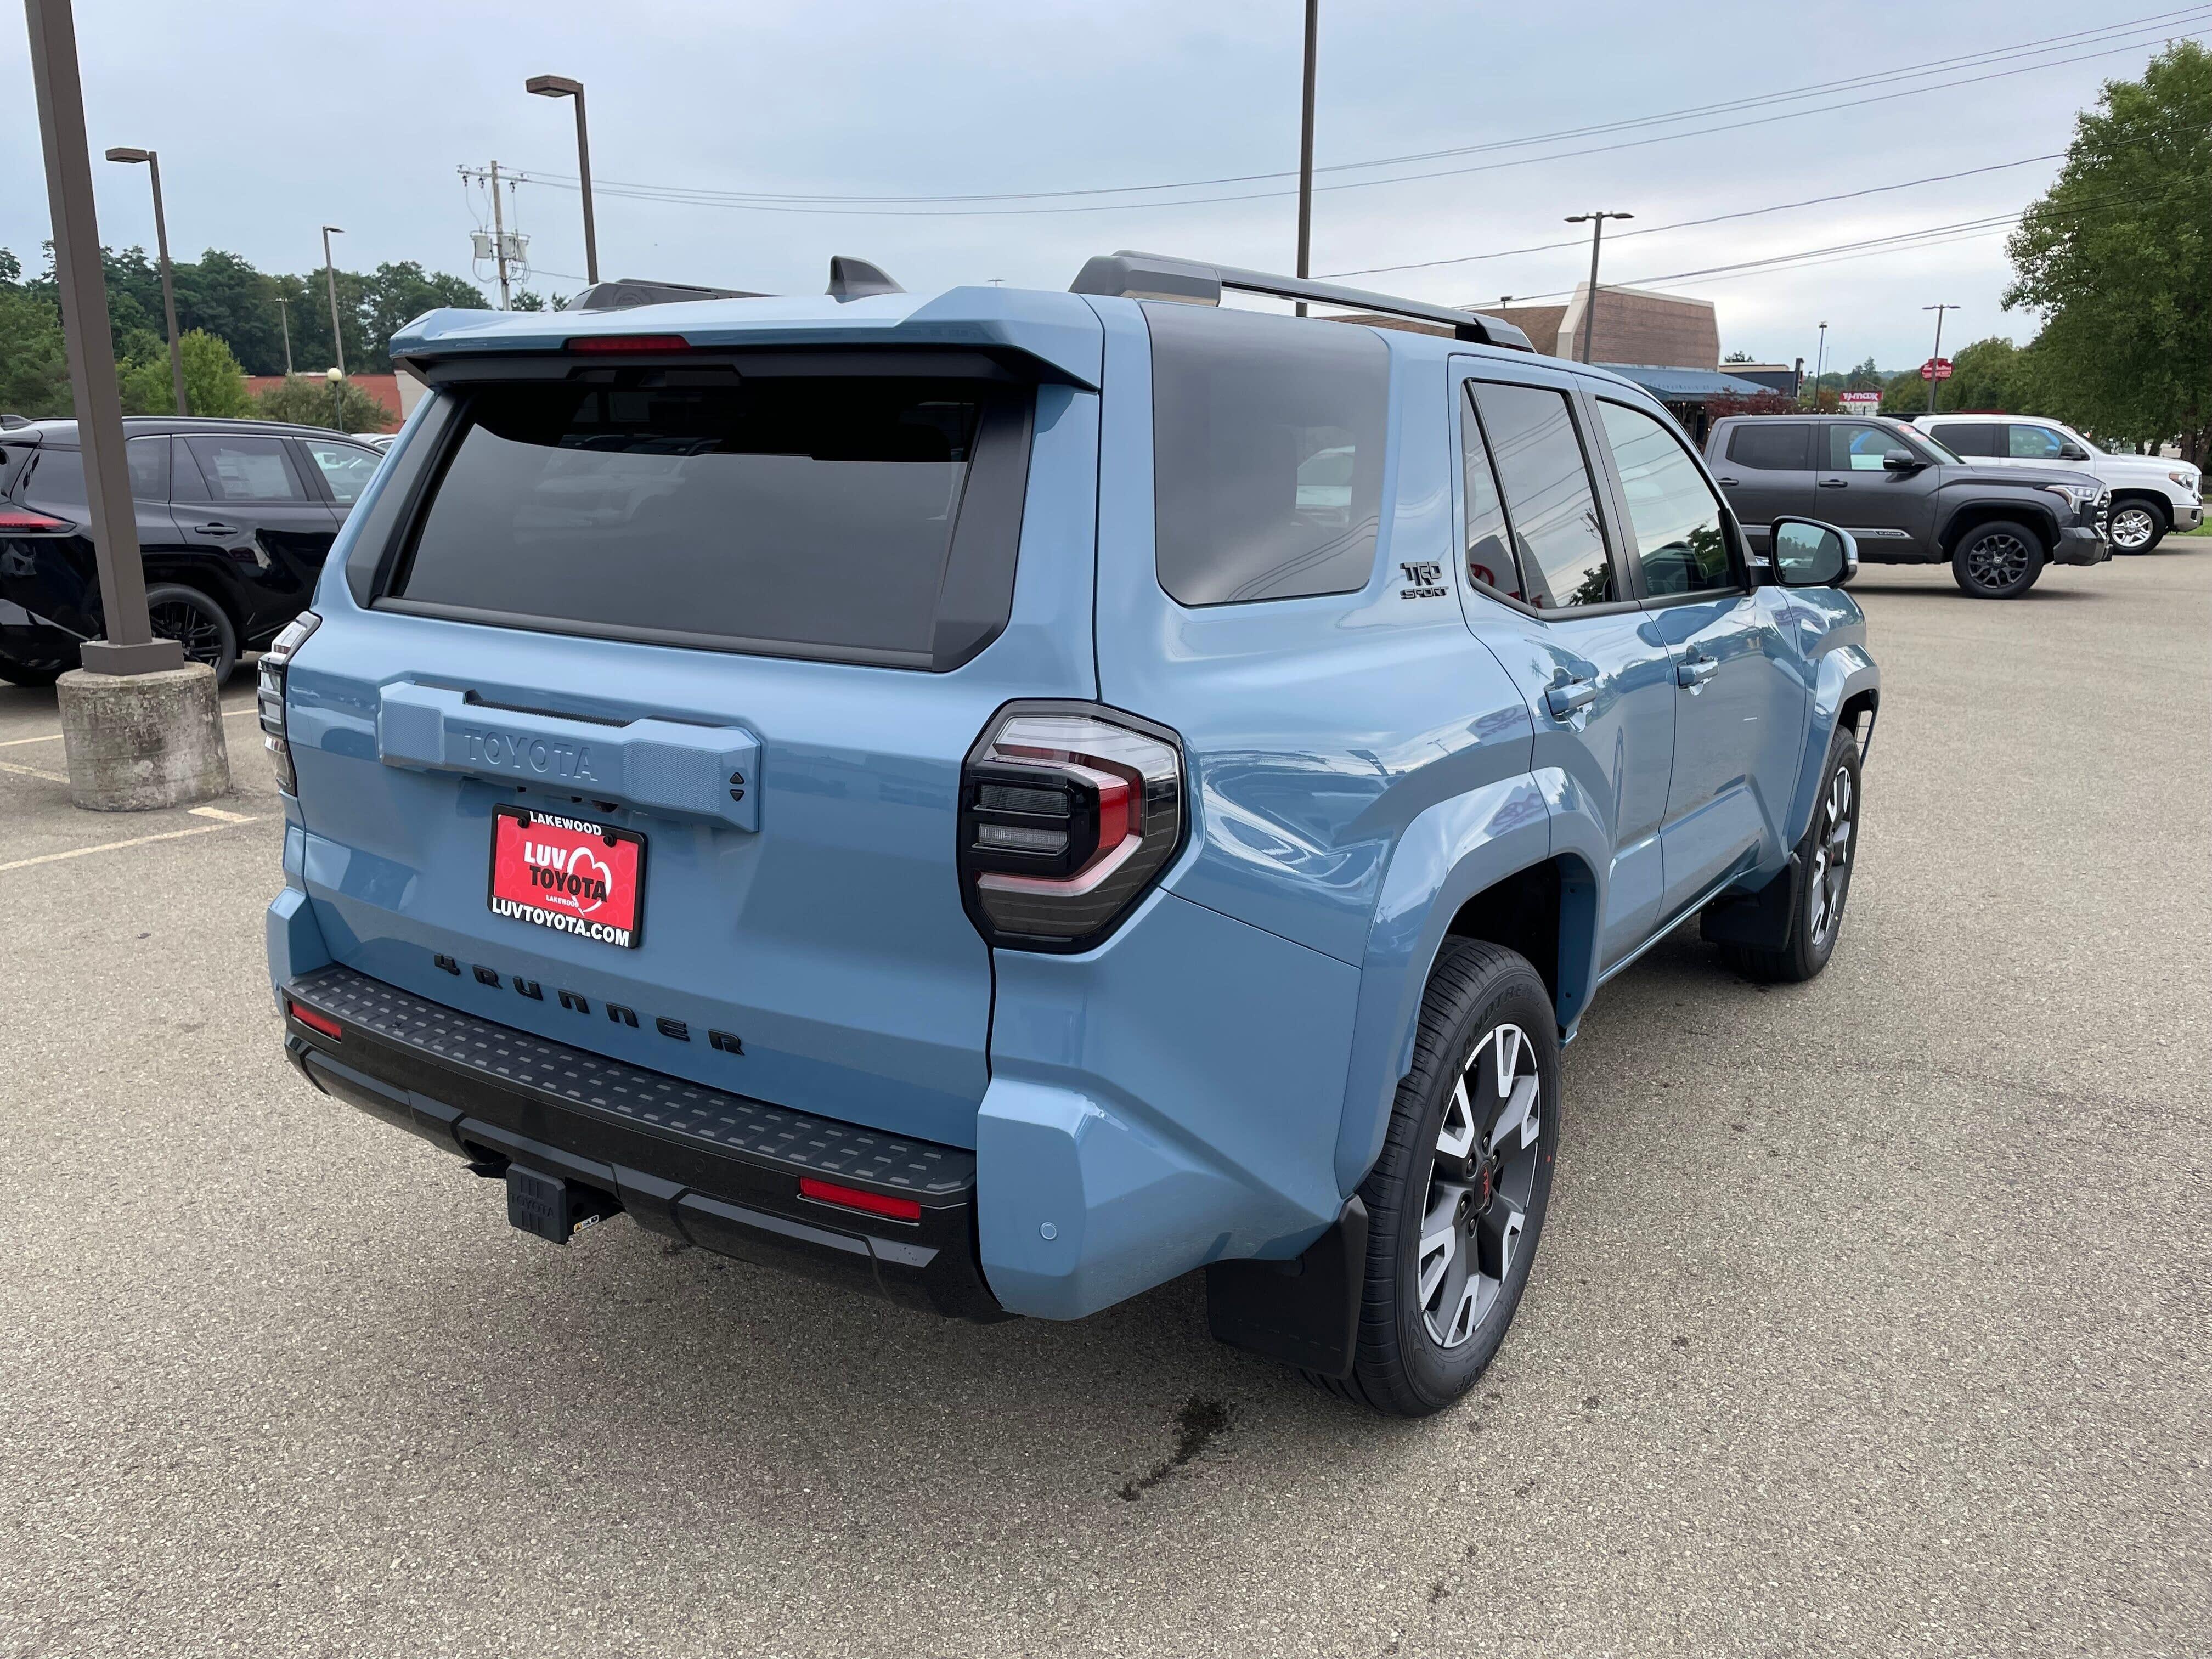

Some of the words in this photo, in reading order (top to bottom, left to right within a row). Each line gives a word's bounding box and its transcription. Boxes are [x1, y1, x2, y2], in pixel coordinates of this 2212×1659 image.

[1400, 561, 1442, 586] TRD
[1400, 586, 1449, 600] SPORT
[464, 728, 599, 782] TOYOTA
[529, 811, 602, 836] LAKEWOOD
[524, 841, 567, 870] LUV
[529, 865, 607, 903] TOYOTA
[546, 895, 579, 908] LAKEWOOD
[492, 896, 630, 947] LUVTOYOTA.COM
[434, 953, 746, 1056] 4RUNNER
[509, 1192, 554, 1217] TOYOTA
